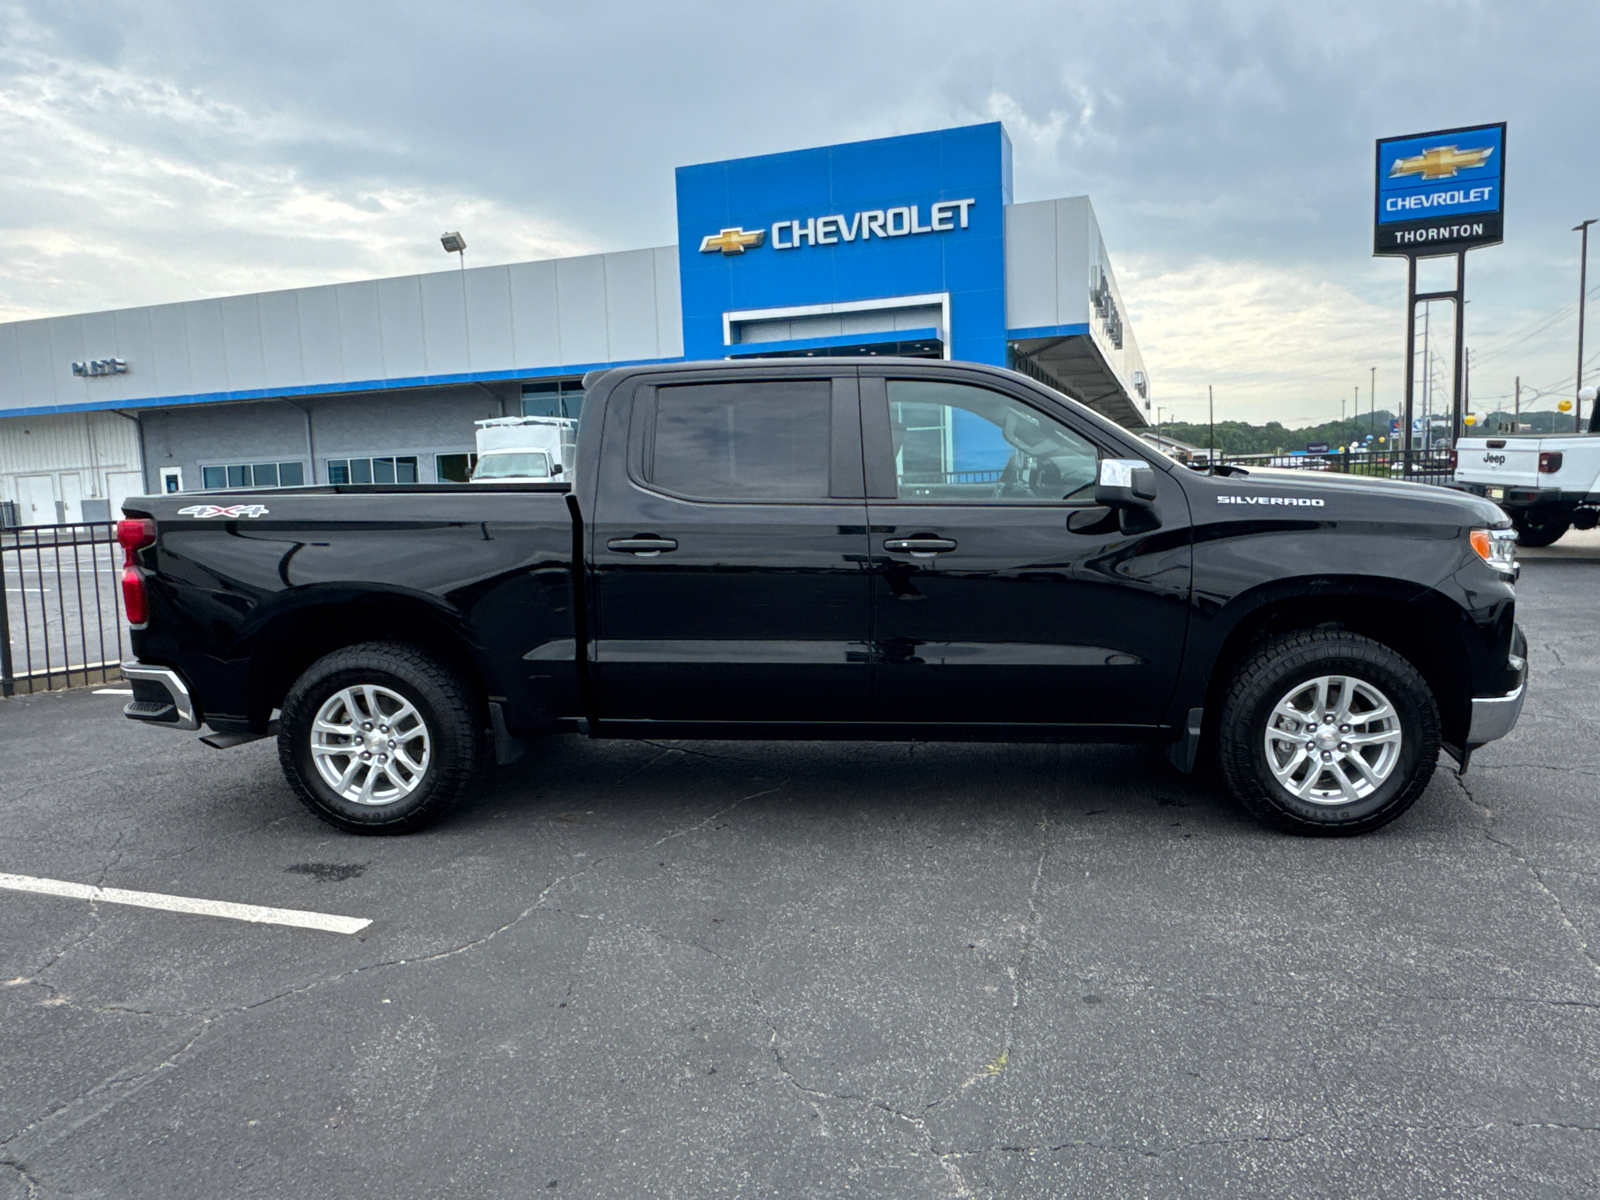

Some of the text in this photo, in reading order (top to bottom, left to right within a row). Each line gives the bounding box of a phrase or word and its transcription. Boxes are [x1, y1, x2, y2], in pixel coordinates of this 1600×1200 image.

[1386, 187, 1493, 211] CHEVROLET
[771, 198, 975, 250] CHEVROLET
[1395, 223, 1483, 243] THORNTON
[1483, 452, 1506, 465] Jeep
[1216, 495, 1325, 507] SILVERADO
